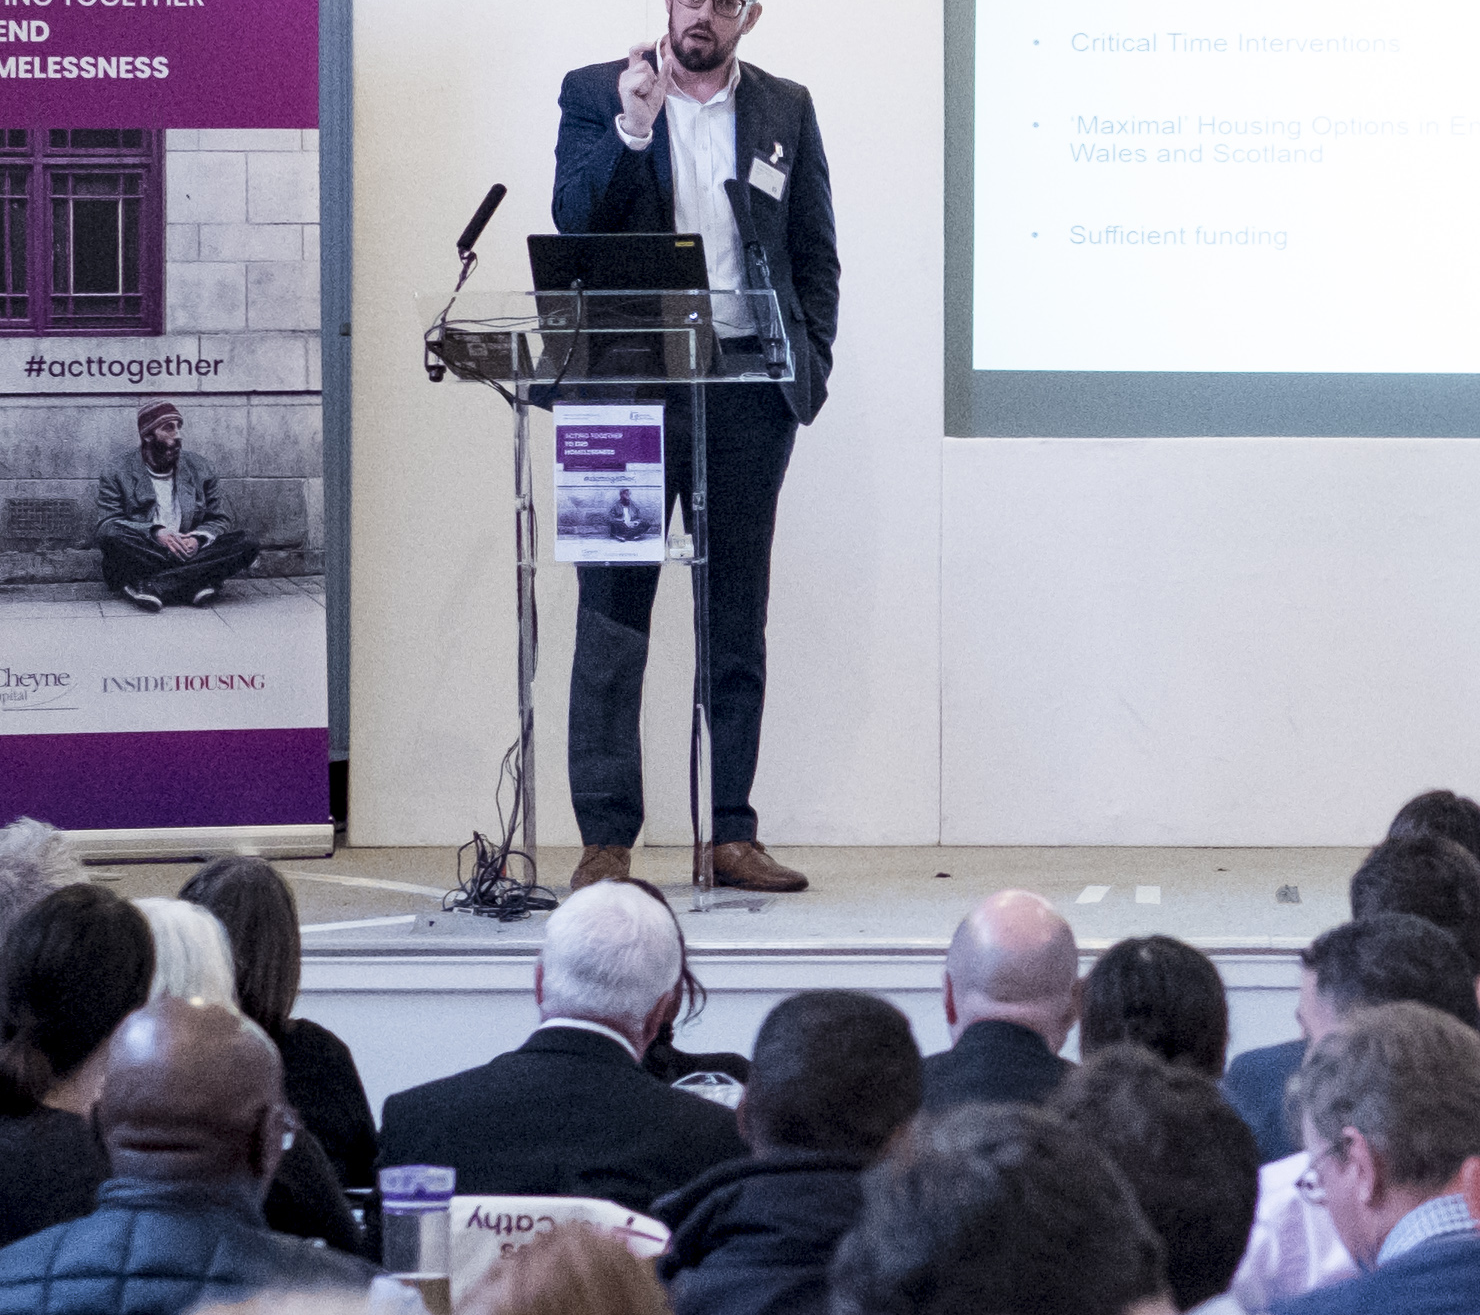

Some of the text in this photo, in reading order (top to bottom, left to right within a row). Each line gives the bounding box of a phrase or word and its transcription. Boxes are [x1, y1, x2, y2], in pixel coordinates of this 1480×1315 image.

[1070, 32, 1401, 54] Critical Time Interventions
[1197, 116, 1302, 141] Housing
[1311, 116, 1410, 140] Options
[1069, 143, 1324, 164] Wales and Scotland
[1069, 225, 1289, 252] Sufficient funding
[24, 354, 224, 383] #acttogether
